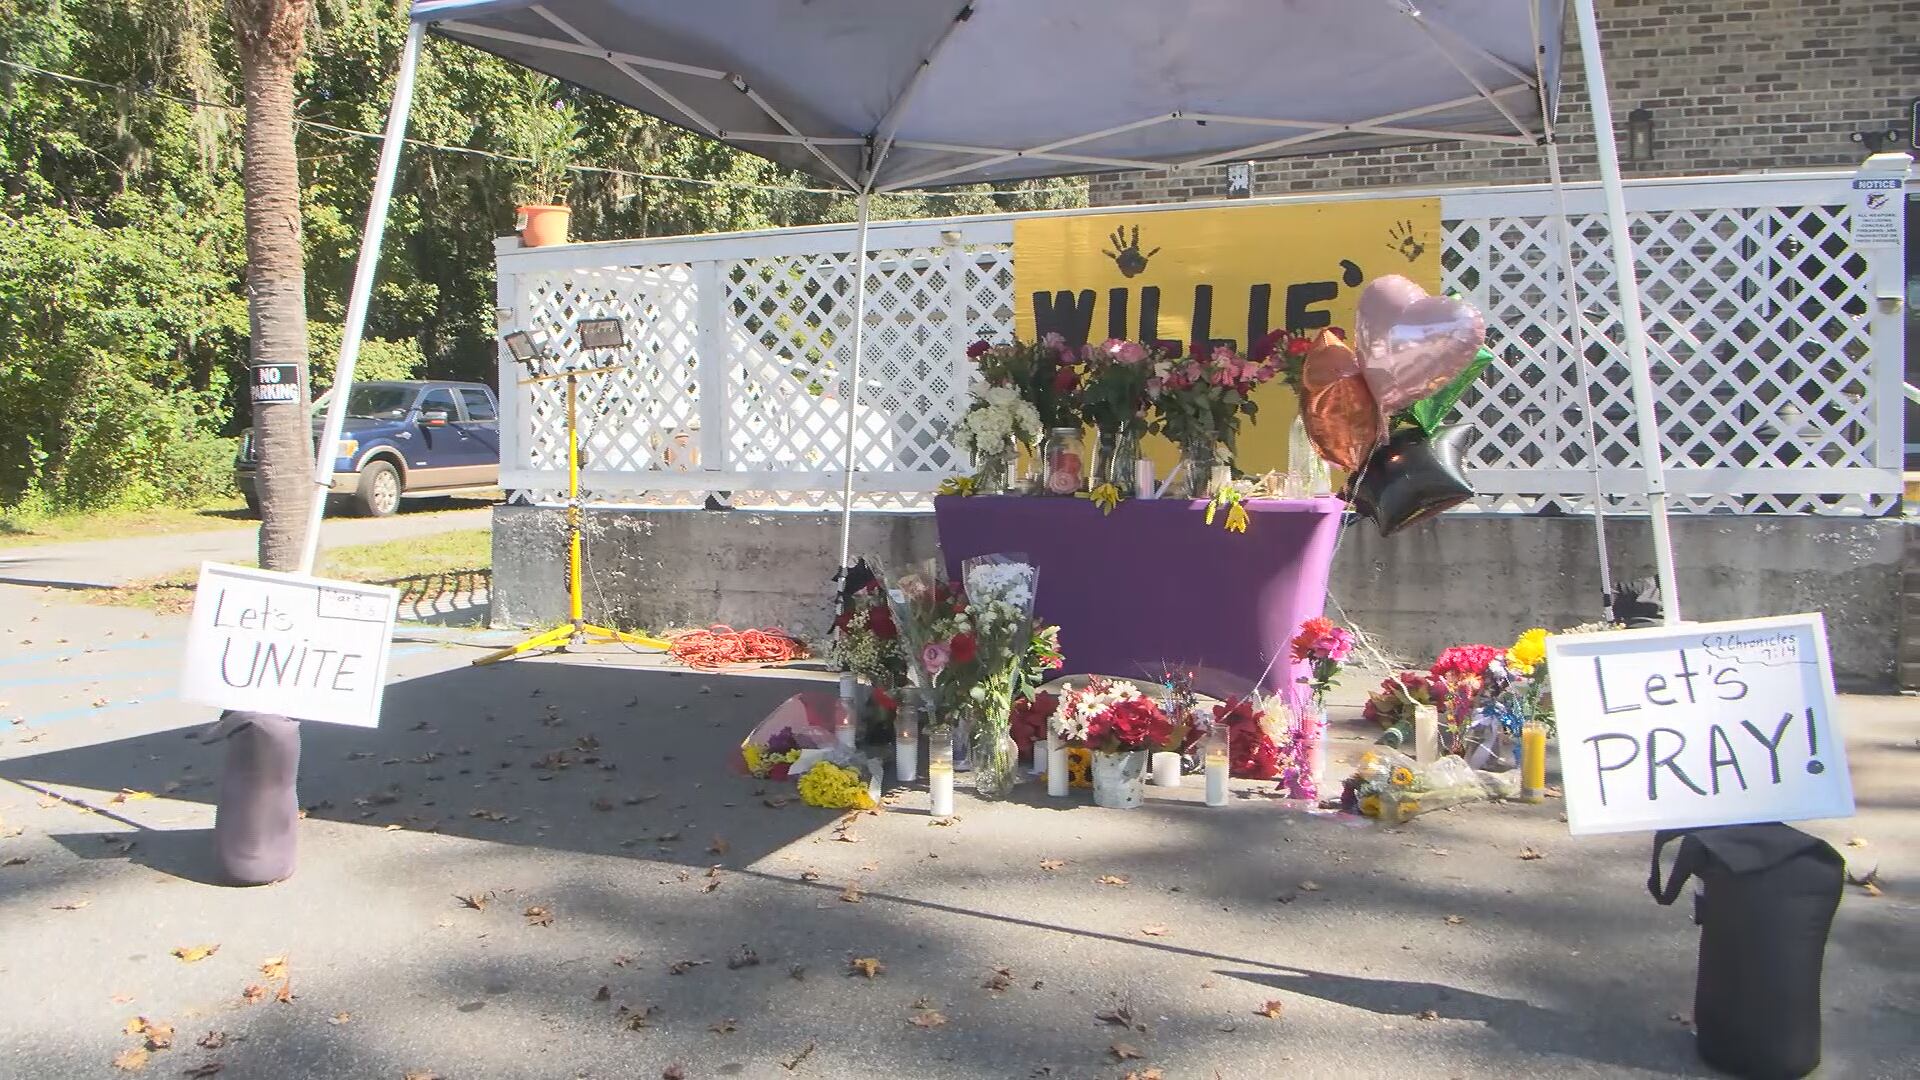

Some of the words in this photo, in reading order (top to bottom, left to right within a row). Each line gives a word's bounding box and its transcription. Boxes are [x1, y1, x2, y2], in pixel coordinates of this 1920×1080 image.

[1858, 180, 1896, 189] NOTICE
[1033, 259, 1364, 362] WILLIE'
[259, 367, 280, 384] NO
[1727, 632, 1796, 650] Chronicles
[1761, 645, 1796, 660] 7:14
[1594, 649, 1748, 715] Let's
[1582, 707, 1825, 806] PRAY!
